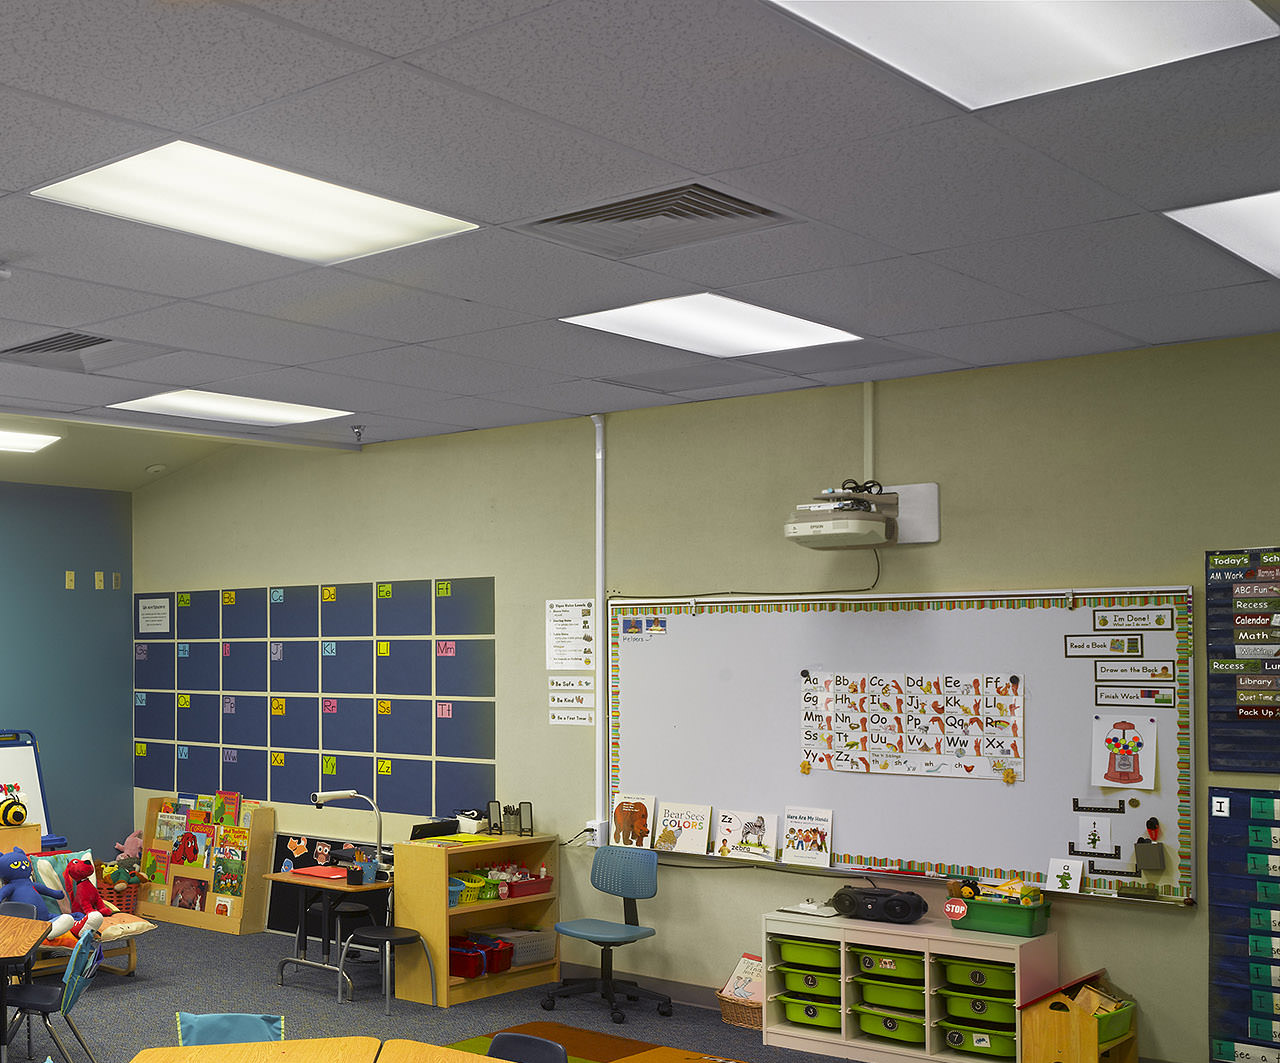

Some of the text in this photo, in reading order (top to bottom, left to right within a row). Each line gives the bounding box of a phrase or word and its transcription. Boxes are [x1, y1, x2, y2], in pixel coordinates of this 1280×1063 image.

[1214, 557, 1249, 566] Today's
[1210, 571, 1244, 580] AM Work
[378, 585, 391, 597] Ee
[437, 582, 450, 595] Ff
[1234, 586, 1268, 594] ABC Fun
[322, 589, 335, 600] Dd
[1236, 601, 1268, 609] Recess
[1127, 614, 1150, 622] Done!
[1235, 616, 1270, 625] Calendar
[1238, 631, 1269, 640] Math
[323, 643, 336, 655] Kk
[378, 642, 389, 654] Ll
[437, 642, 455, 655] Mm
[1213, 662, 1244, 670] Recess
[804, 674, 818, 685] Aa
[835, 676, 849, 686] Bb
[869, 676, 884, 687] Cc
[906, 676, 923, 687] Dd
[945, 676, 960, 688] Ee
[985, 676, 1001, 688] Ff
[1239, 678, 1272, 686] Library
[803, 692, 818, 706] Gg
[835, 694, 850, 704] Hh
[870, 694, 880, 705] Ii
[906, 695, 919, 709] Jj
[945, 696, 961, 707] Kk
[985, 696, 996, 708] Ll
[1239, 693, 1273, 701] Quiet Time
[323, 700, 337, 712] Rr
[378, 701, 391, 714] Ss
[438, 703, 451, 716] Tt
[803, 711, 824, 722] Mm
[835, 713, 851, 723] Nn
[1238, 708, 1273, 717] Pack Up
[870, 713, 887, 724] Oo
[907, 714, 921, 729] Pp
[945, 715, 964, 730] Qq
[804, 730, 818, 741] Ss
[835, 732, 848, 743] Tt
[870, 733, 887, 744] Uu
[907, 735, 923, 746] Vv
[946, 736, 969, 748] Ww
[985, 737, 1004, 749] Xx
[272, 753, 283, 765] Xx
[803, 749, 818, 763] Yy
[835, 750, 850, 762] Zz
[323, 757, 336, 774] Yy
[378, 760, 391, 773] Zz
[1216, 801, 1225, 812] I
[663, 808, 705, 821] Bear Sees
[721, 814, 733, 824] Zz
[662, 818, 704, 830] COLORS
[731, 844, 751, 852] zebra
[945, 903, 966, 914] STOP
[1234, 1050, 1251, 1059] see
